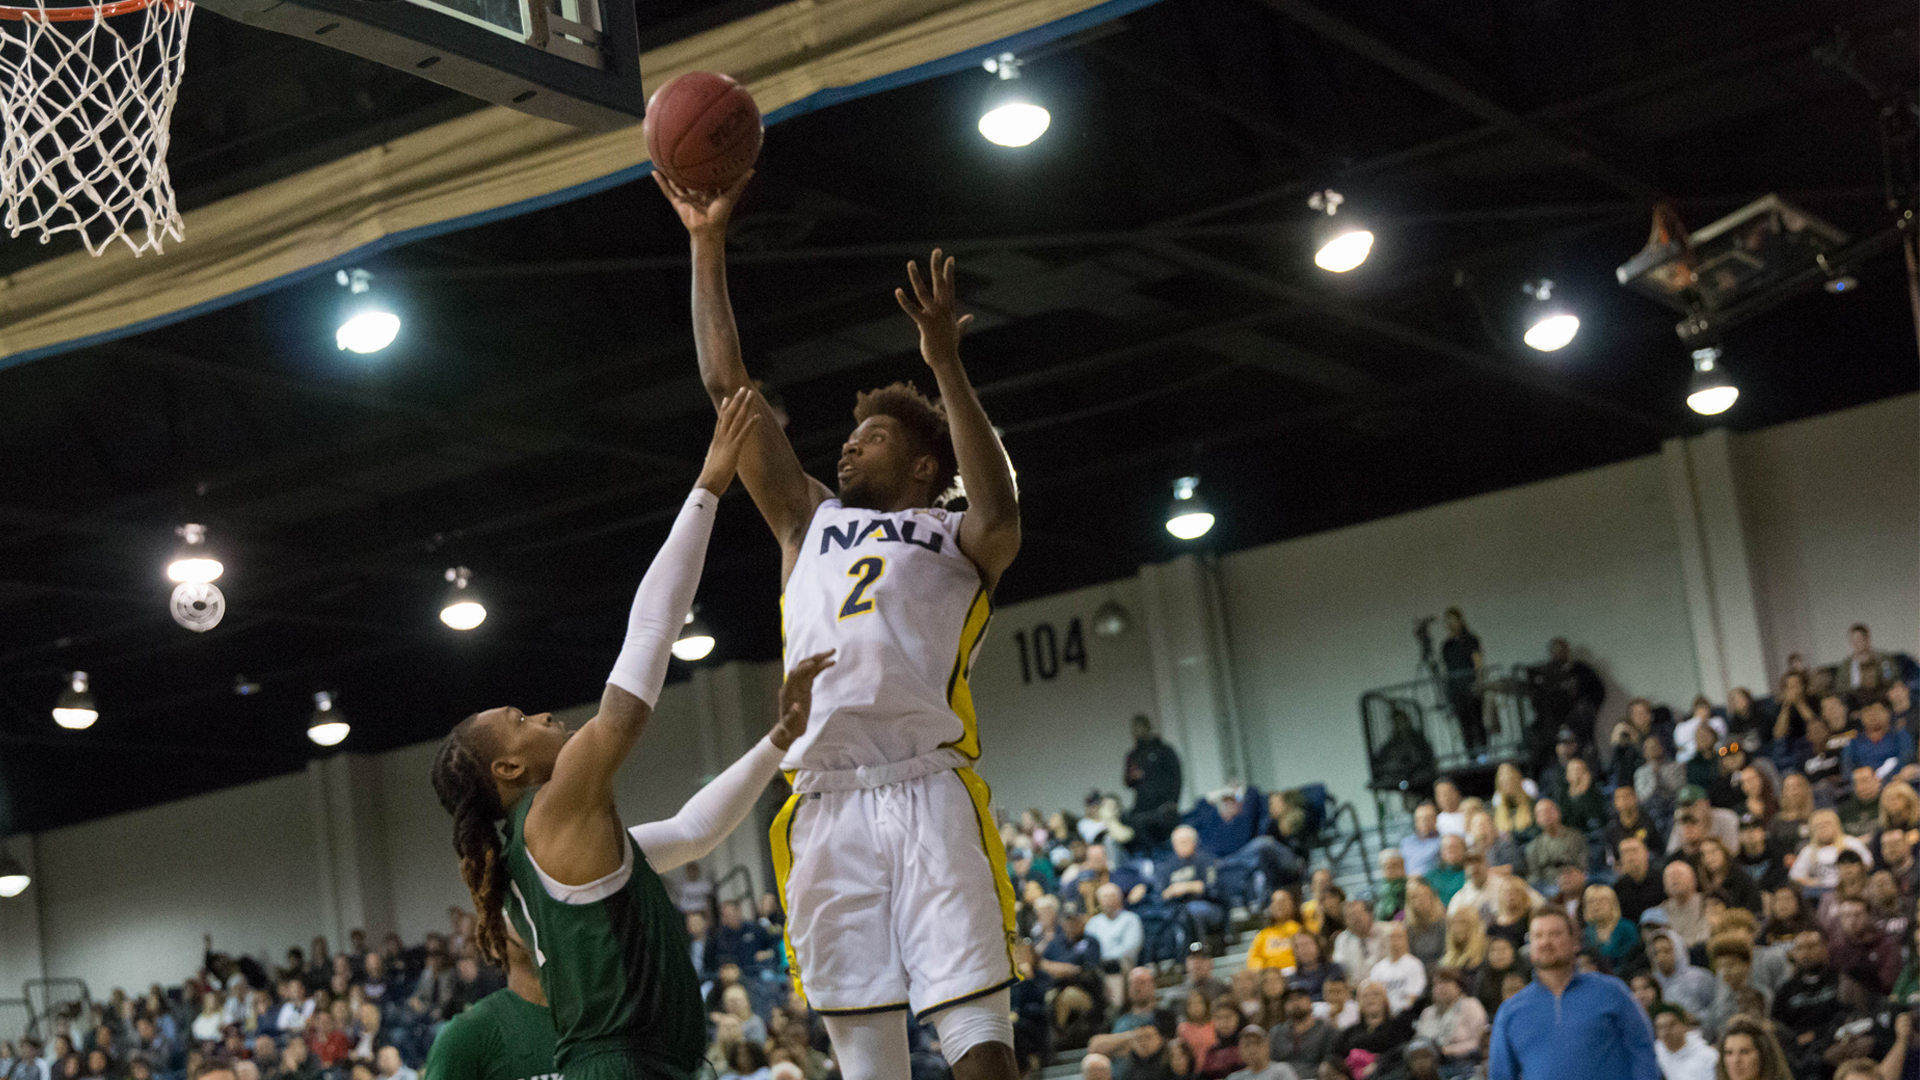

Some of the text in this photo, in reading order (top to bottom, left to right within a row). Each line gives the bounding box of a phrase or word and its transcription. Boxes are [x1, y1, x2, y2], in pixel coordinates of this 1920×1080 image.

[820, 518, 944, 555] NAU
[838, 555, 886, 622] 2
[1014, 616, 1088, 684] 104
